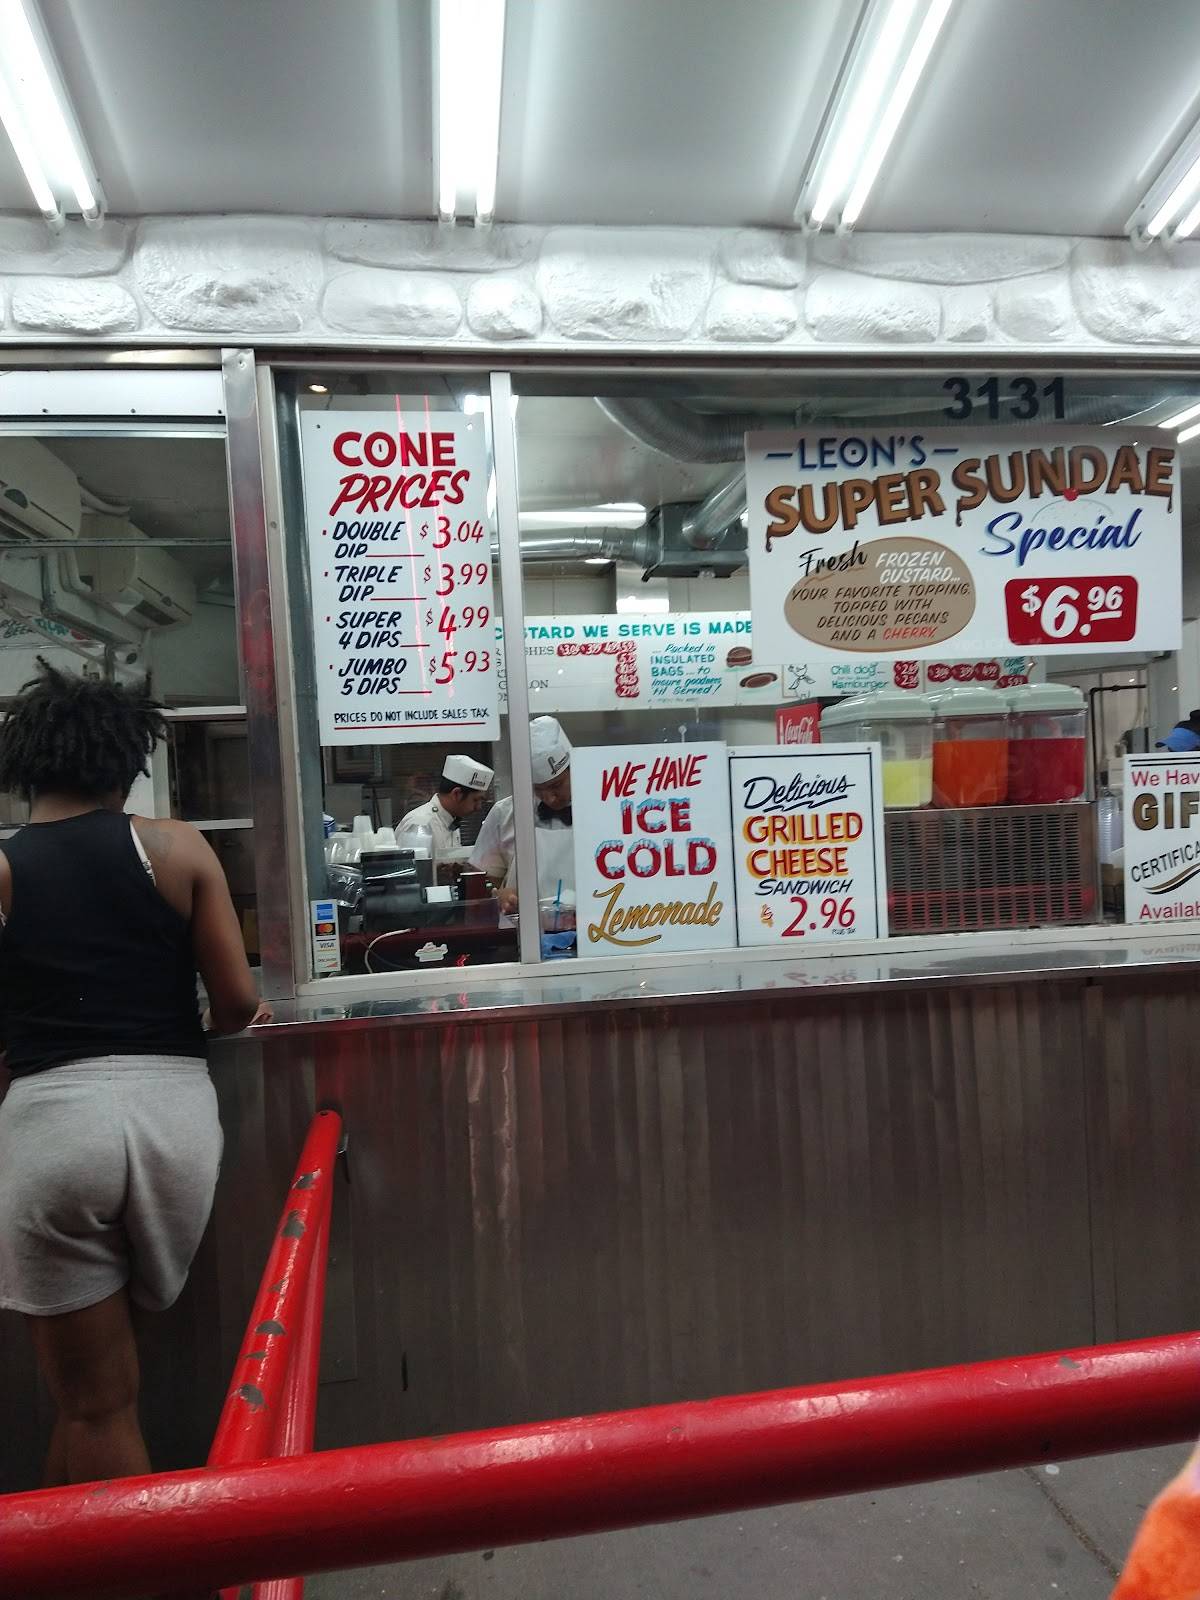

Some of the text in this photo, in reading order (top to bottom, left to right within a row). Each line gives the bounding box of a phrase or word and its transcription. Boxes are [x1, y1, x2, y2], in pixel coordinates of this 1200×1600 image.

[942, 377, 1065, 420] 3131
[332, 431, 456, 468] CONE
[799, 435, 926, 470] LEON'S
[329, 469, 470, 517] PRICES
[765, 444, 1175, 537] SUPER SUNDAE
[332, 516, 484, 549] DOUBLE $3.04
[979, 508, 1143, 567] Special
[334, 543, 368, 559] DIP
[798, 540, 868, 577] Fresh
[875, 551, 946, 568] FROZEN
[334, 563, 488, 596] TRIPLE $3.99
[338, 585, 374, 602] DIP
[792, 588, 828, 600] YOUR
[834, 585, 901, 598] FAVORITE
[816, 612, 950, 628] DELICIOUS PECANS
[833, 599, 933, 613] TOPPED WITH
[1020, 584, 1124, 639] $6.96
[335, 606, 490, 640] SUPER $4.99
[583, 625, 609, 638] WE
[618, 623, 675, 636] SERVE
[684, 622, 701, 635] IS
[709, 621, 752, 634] MADE
[830, 630, 862, 641] AND
[866, 628, 876, 640] A
[338, 631, 402, 650] 4 DIPS
[338, 658, 407, 677] JUMBO
[428, 651, 490, 684] $5.93
[650, 654, 716, 664] INSULATED
[697, 666, 711, 675] to
[340, 678, 401, 695] 5 DIPS
[334, 708, 490, 723] PRICES DO NOT INCLUDE SALES TAX
[601, 762, 646, 801] WE
[646, 754, 708, 795] HAVE
[743, 773, 856, 809] Delicious
[1132, 770, 1160, 787] We
[620, 797, 692, 835] ICE
[1133, 791, 1200, 831] GIF
[743, 812, 863, 845] GRILLED
[594, 837, 717, 880] COLD
[747, 846, 849, 879] CHEESE
[755, 878, 853, 896] SANDWICH
[588, 881, 723, 947] Lemonade
[761, 896, 856, 938] $2.96
